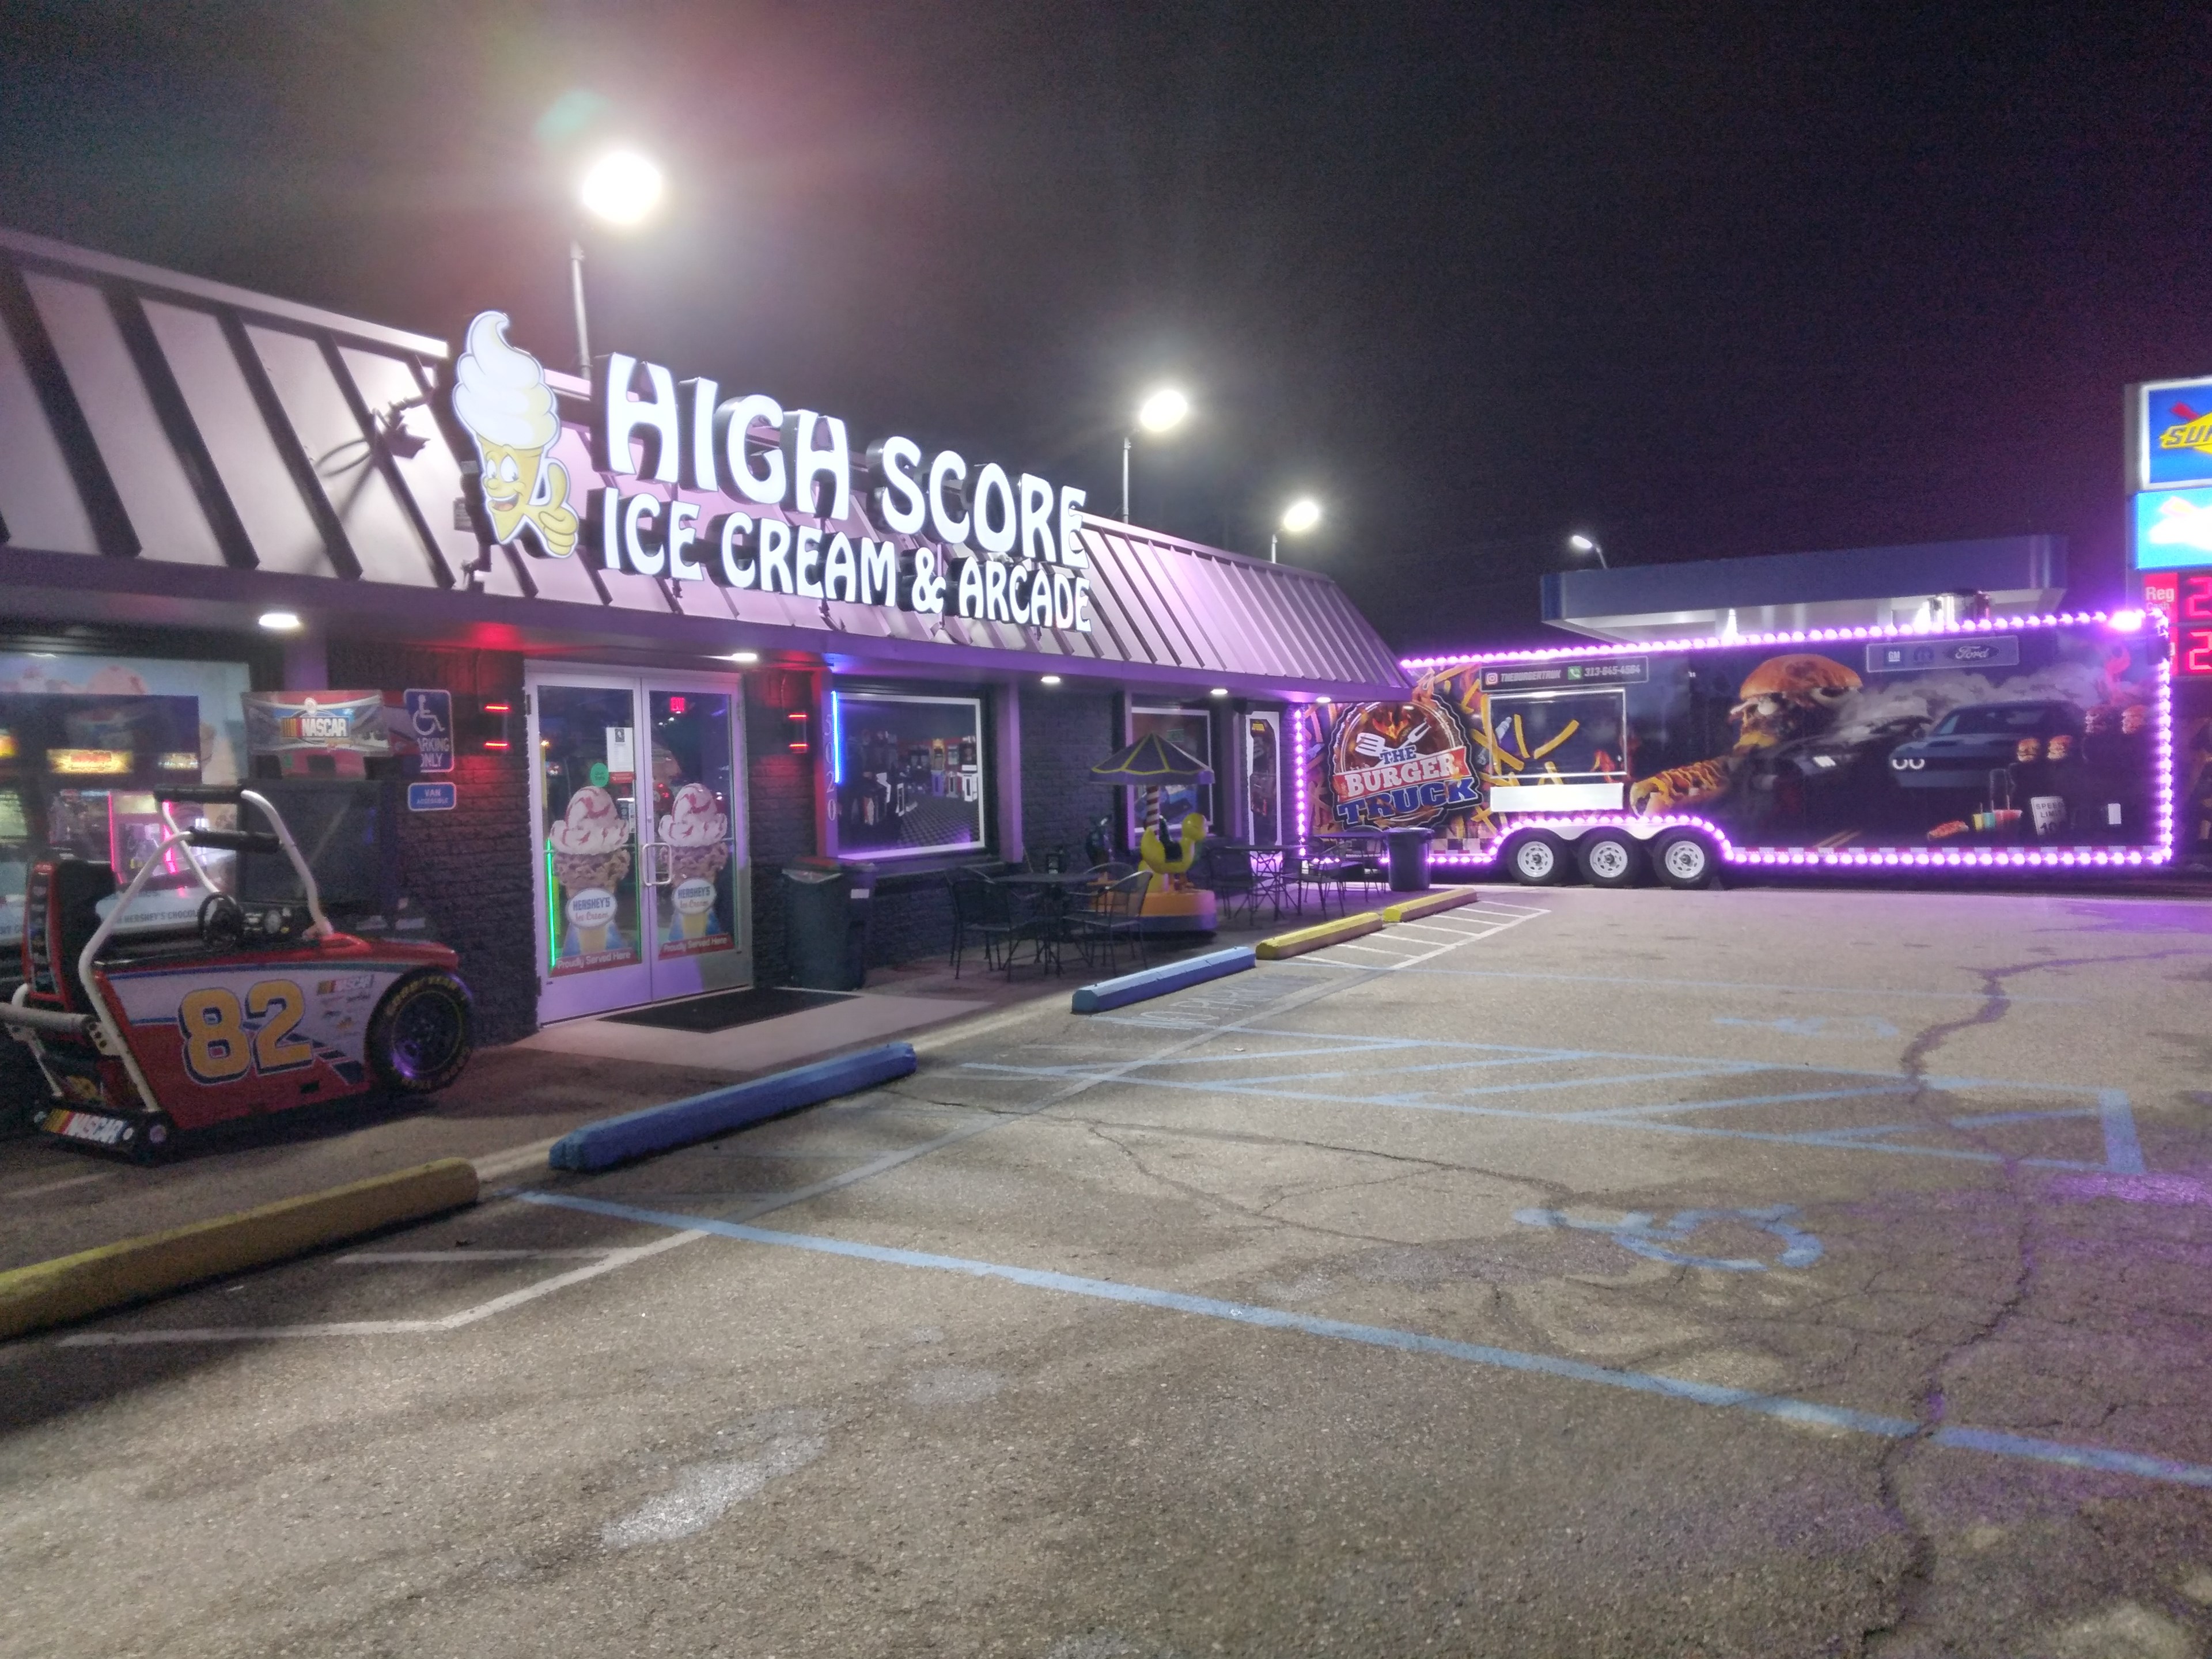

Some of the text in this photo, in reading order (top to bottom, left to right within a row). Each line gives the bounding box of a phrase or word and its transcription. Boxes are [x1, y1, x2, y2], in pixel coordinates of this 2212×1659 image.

[607, 351, 1088, 569] HIGH SCORE
[601, 487, 1092, 632] ICE CREAM & ARCADE
[2145, 586, 2175, 603] Reg
[1888, 645, 1990, 662] GM Ford
[302, 718, 346, 737] NASCAR
[416, 737, 449, 752] ARKING
[1380, 745, 1416, 764] THE
[1344, 753, 1457, 797] BURGER
[425, 789, 441, 797] VAN
[1337, 777, 1479, 825] TRUCK
[677, 887, 710, 899] HERSHEY'S
[573, 897, 611, 911] HERSHEY'S
[575, 911, 609, 922] Ice Cream
[664, 937, 728, 953] Proudly Served Here
[558, 951, 631, 969] Proudly Served Here
[179, 979, 313, 1086] 82
[64, 1111, 124, 1145] NASCAR
